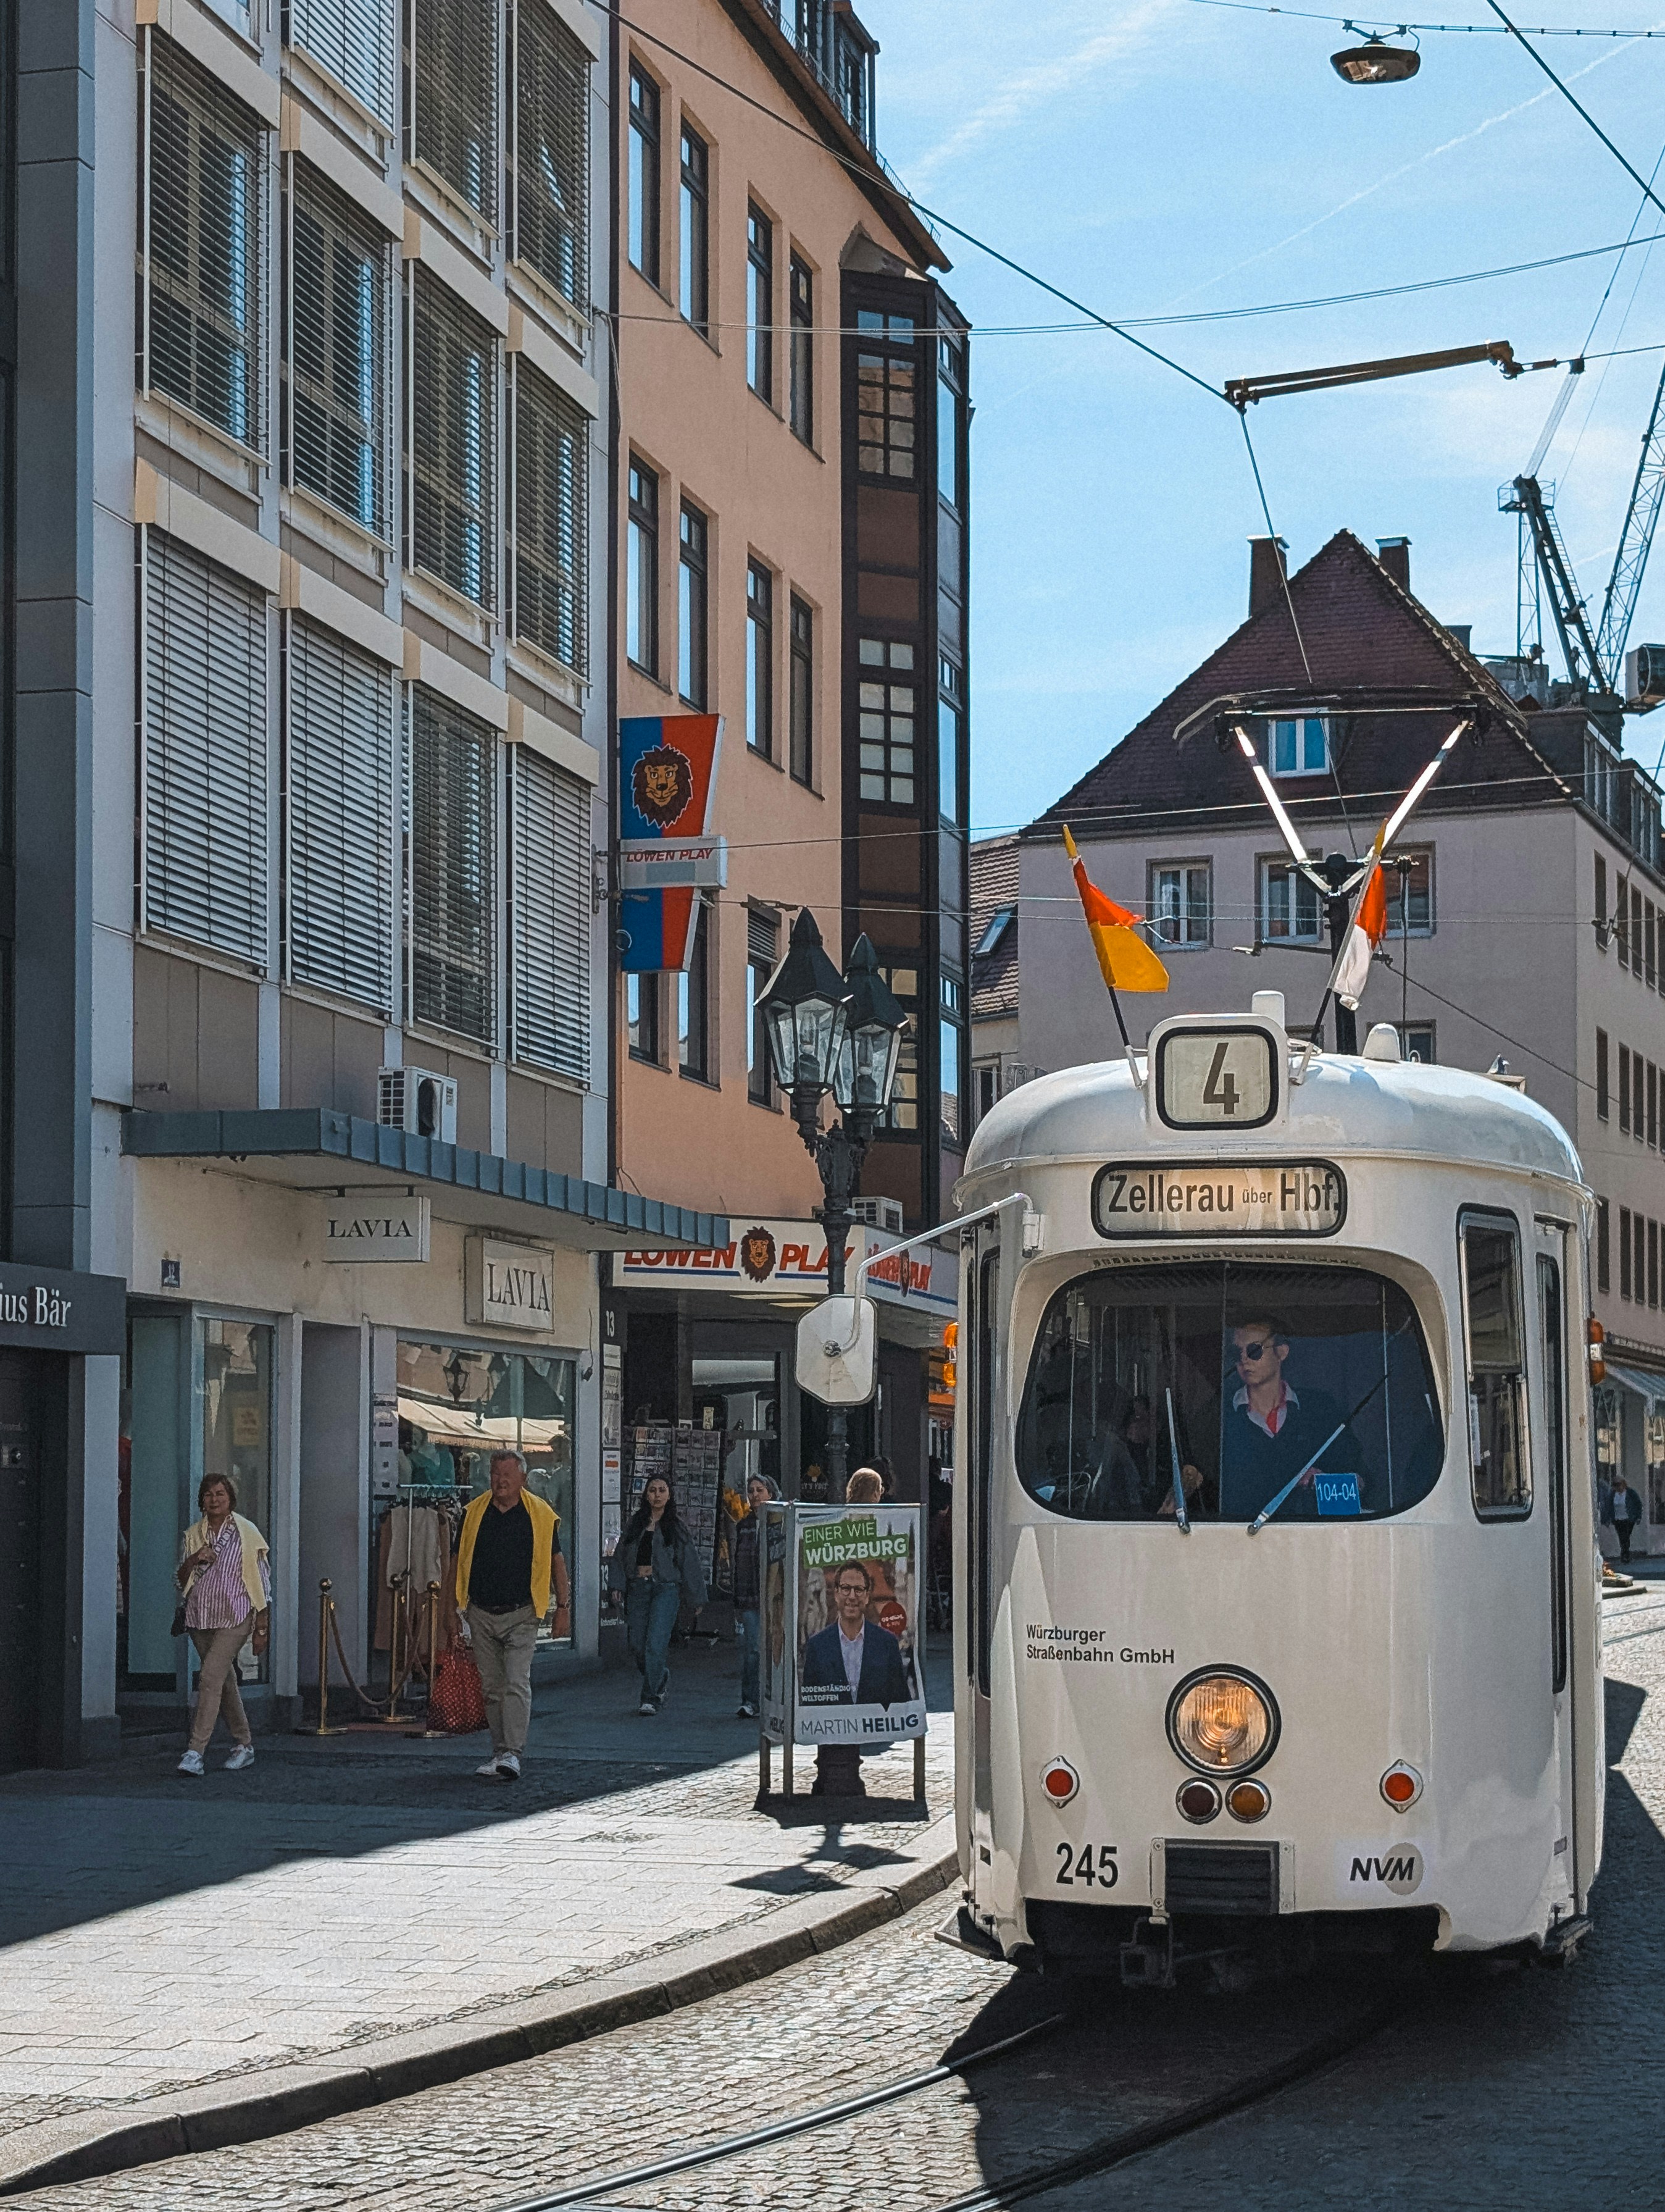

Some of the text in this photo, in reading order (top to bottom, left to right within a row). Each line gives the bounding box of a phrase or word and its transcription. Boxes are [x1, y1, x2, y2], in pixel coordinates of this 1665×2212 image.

[679, 848, 713, 861] PLAY
[1203, 1042, 1240, 1114] 4
[1108, 1174, 1233, 1212] Zellerau
[1242, 1189, 1272, 1204] über
[327, 1219, 413, 1238] LAVIA
[778, 1244, 854, 1272] PLA
[486, 1263, 550, 1312] LAVIA
[35, 1286, 72, 1327] Bär
[606, 1310, 615, 1338] 13
[1317, 1483, 1356, 1501] 104-04
[804, 1522, 875, 1543] EINER WIE
[806, 1538, 906, 1565] WÜRZBURG
[1026, 1624, 1106, 1645] Würzburger
[1027, 1644, 1174, 1664] Straßenbahn GmbH
[801, 1694, 839, 1702] WELTOFFEN
[801, 1714, 919, 1735] MARTIN HEILIG
[1056, 1842, 1119, 1888] 245
[1350, 1857, 1415, 1881] NVM
